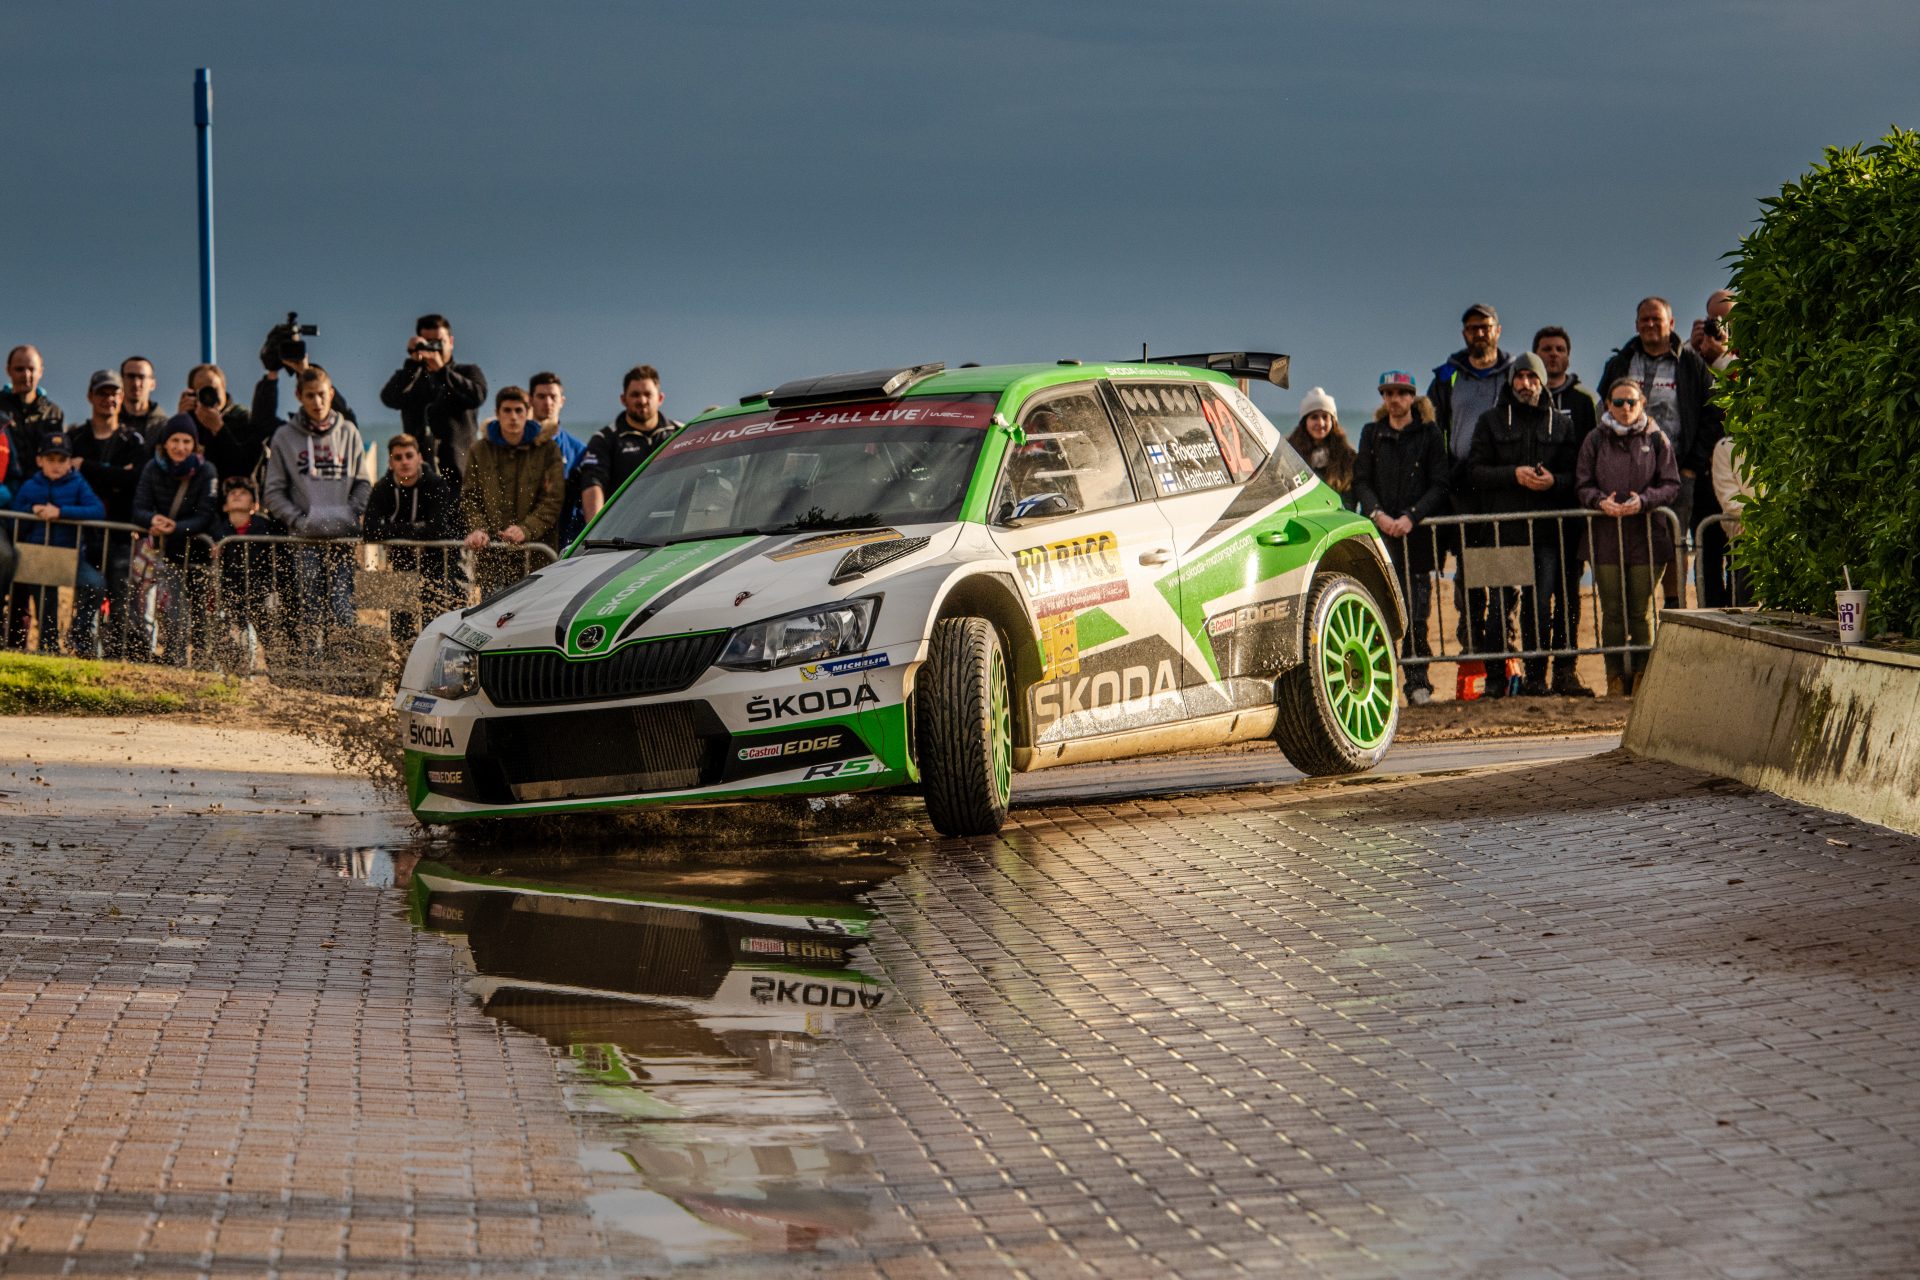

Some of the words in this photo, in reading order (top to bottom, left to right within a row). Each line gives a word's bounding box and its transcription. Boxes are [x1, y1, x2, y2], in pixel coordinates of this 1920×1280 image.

[711, 418, 799, 441] WRC
[869, 409, 921, 423] LIVE
[1020, 547, 1056, 597] 32
[1215, 617, 1234, 632] Castrol
[1236, 599, 1291, 629] EDGE
[832, 656, 887, 671] MICHELIN
[748, 745, 780, 758] Castrol
[783, 734, 843, 756] EDGE
[440, 770, 463, 784] EDGE
[802, 757, 875, 781] R5
